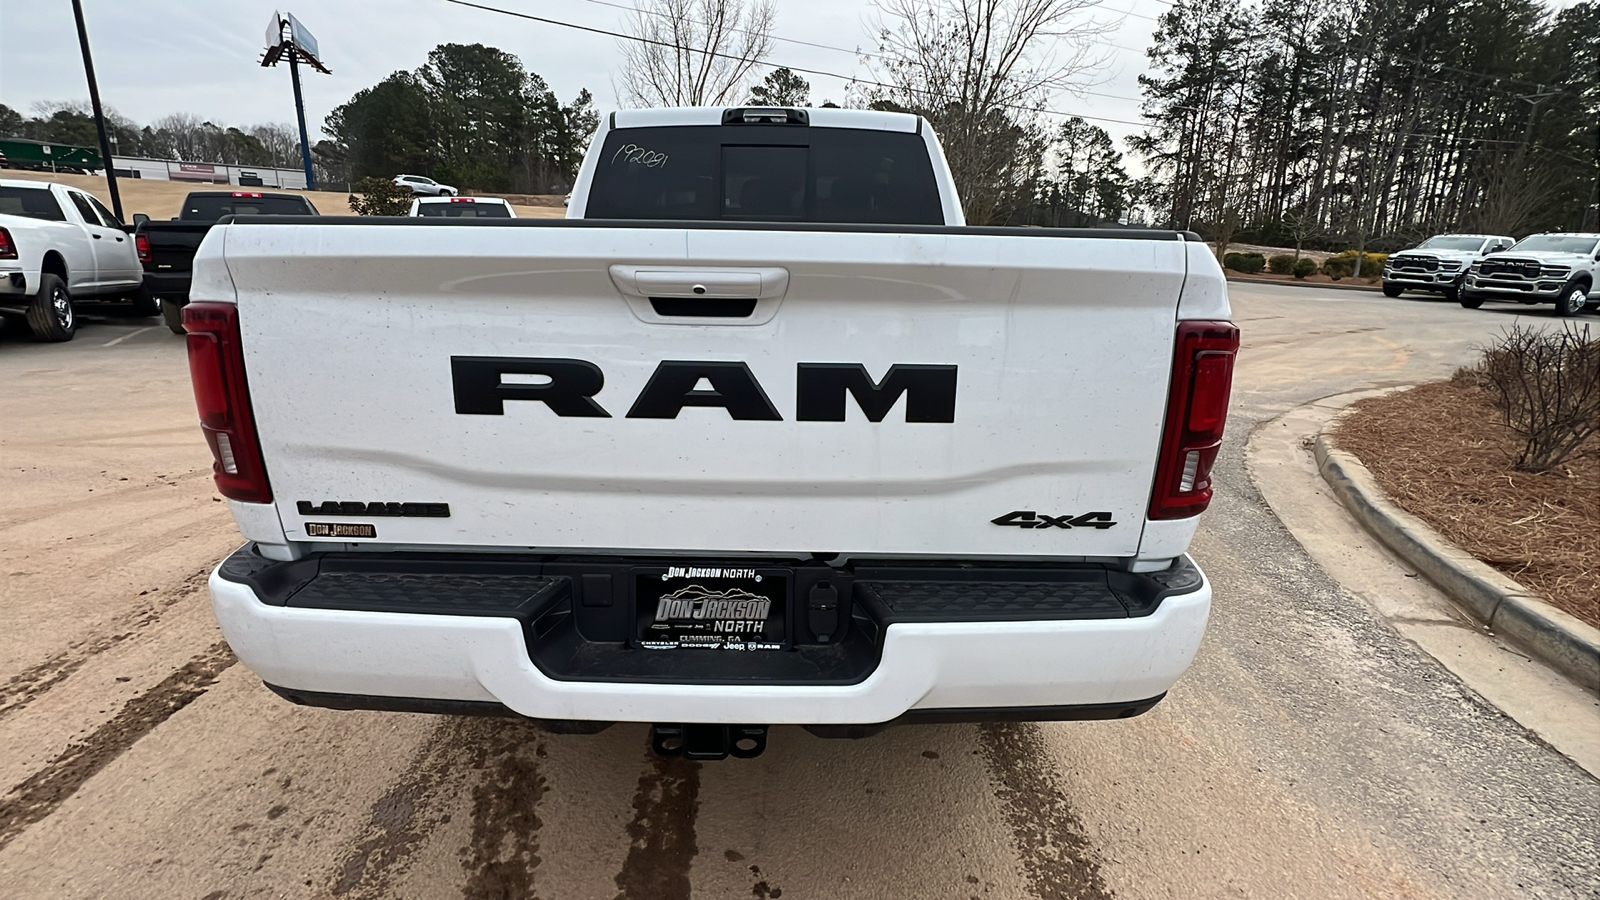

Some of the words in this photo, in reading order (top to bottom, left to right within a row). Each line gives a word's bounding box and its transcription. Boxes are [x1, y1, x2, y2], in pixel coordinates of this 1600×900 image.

[450, 355, 958, 424] RAM
[990, 511, 1118, 529] 4x4
[309, 523, 329, 536] DON
[330, 524, 372, 536] JACKSON
[668, 566, 685, 578] DON
[685, 567, 721, 578] JACKSON
[722, 569, 755, 578] NORTH
[655, 598, 694, 621] DON
[693, 599, 771, 620] JACKSON
[713, 620, 764, 633] NORTH
[723, 642, 745, 651] Jeep
